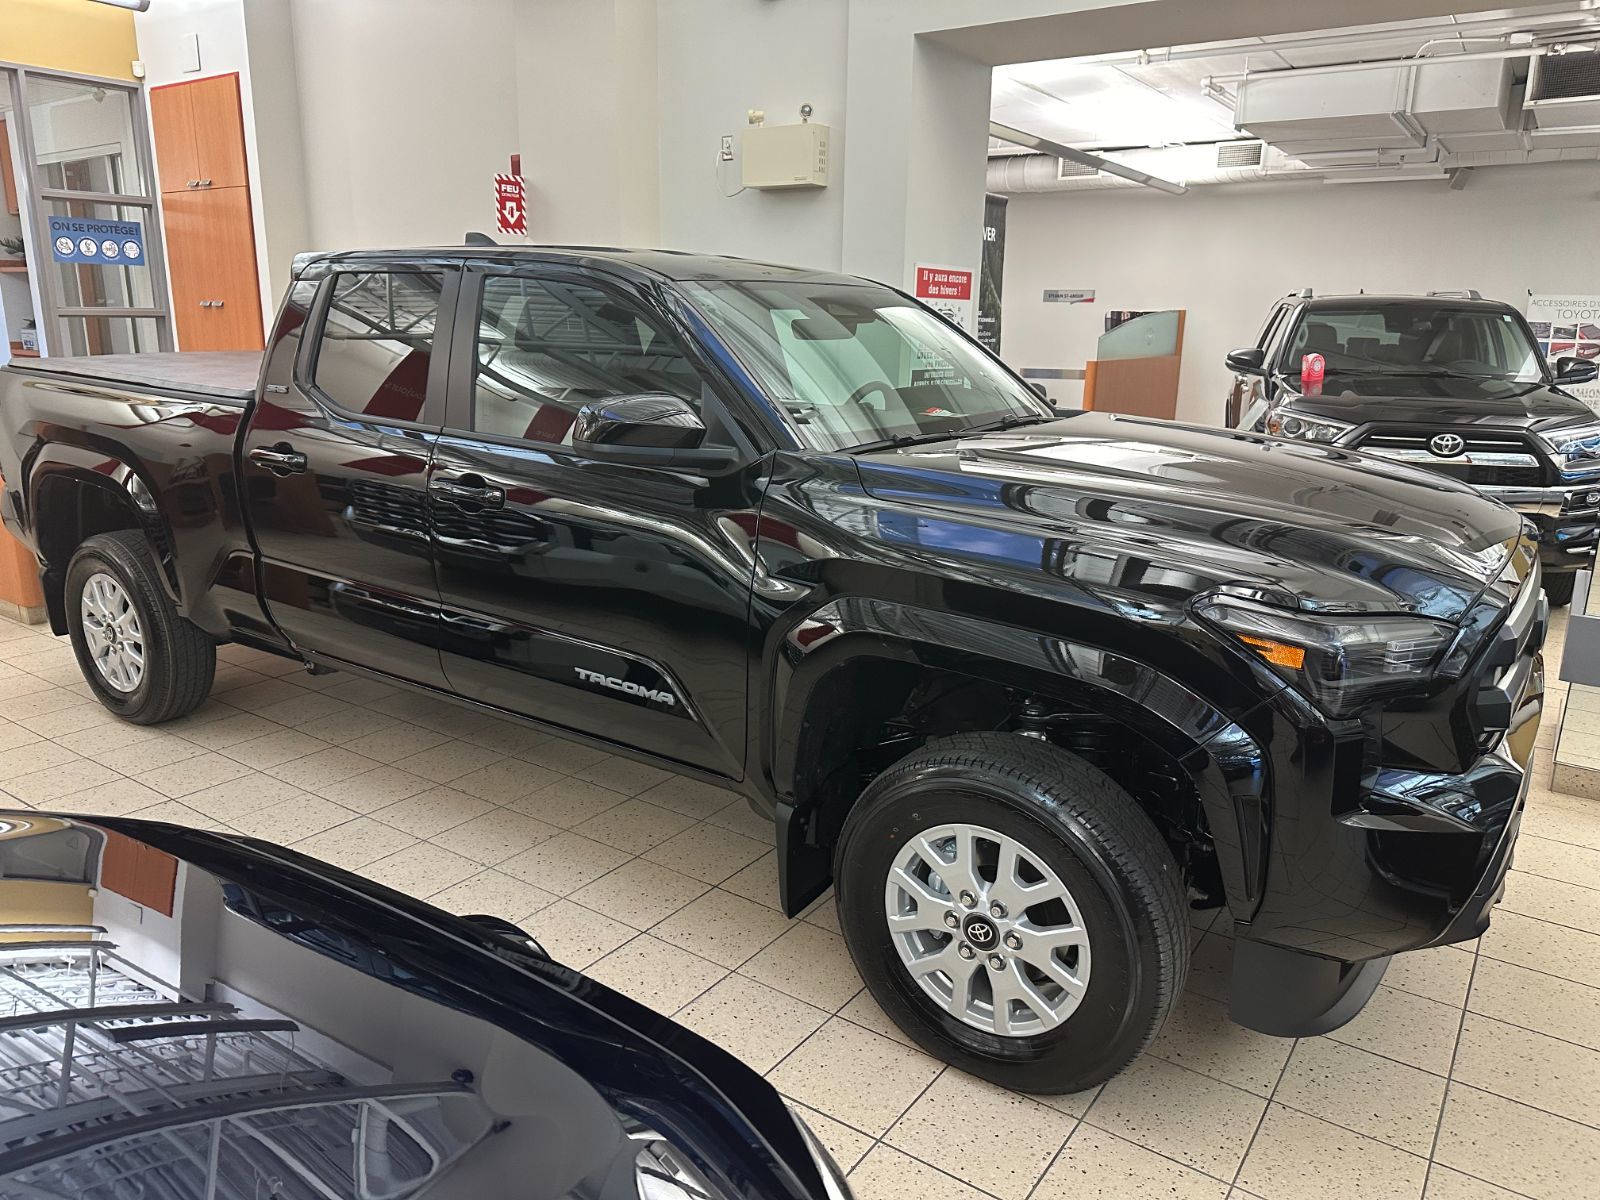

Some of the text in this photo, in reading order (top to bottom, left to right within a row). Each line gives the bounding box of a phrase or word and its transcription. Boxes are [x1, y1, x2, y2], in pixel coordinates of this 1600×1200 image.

[501, 184, 519, 193] FEU
[52, 221, 69, 231] ON
[72, 222, 84, 232] SE
[923, 270, 967, 284] Il y aura encore
[928, 284, 939, 294] des
[939, 285, 958, 296] hivers
[1531, 299, 1588, 308] ACCESSOIRES
[574, 667, 675, 706] TACOMA
